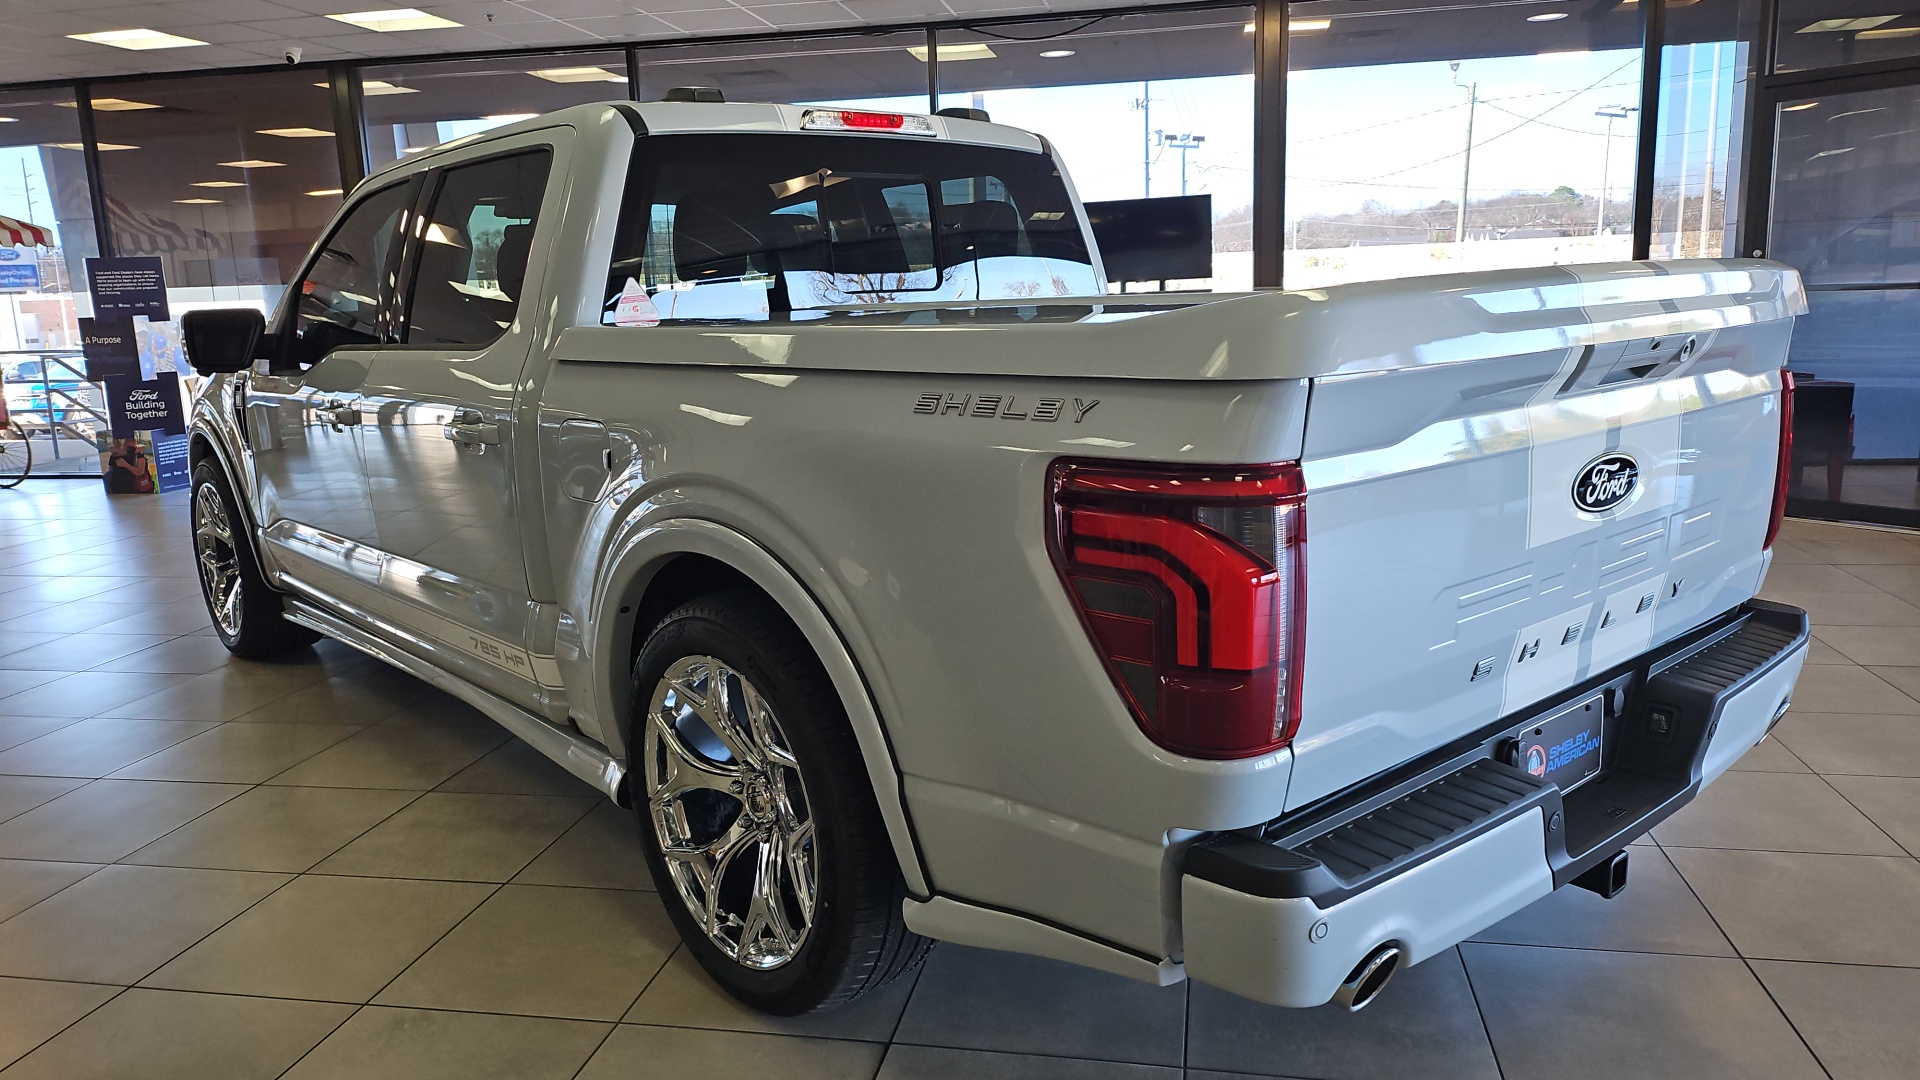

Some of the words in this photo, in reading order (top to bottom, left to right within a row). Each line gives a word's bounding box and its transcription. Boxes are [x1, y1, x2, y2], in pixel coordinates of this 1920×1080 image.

[85, 336, 91, 344] A
[92, 336, 122, 345] Purpose
[125, 401, 166, 410] Building
[129, 389, 159, 401] Ford
[913, 391, 1100, 423] SHELBY
[124, 410, 168, 420] Together
[1586, 462, 1630, 504] Ford
[1469, 577, 1686, 683] SHELBY
[468, 635, 502, 660] 785
[503, 650, 526, 667] HP
[1545, 736, 1600, 774] AMERICAN
[1549, 729, 1591, 760] SHELBY
